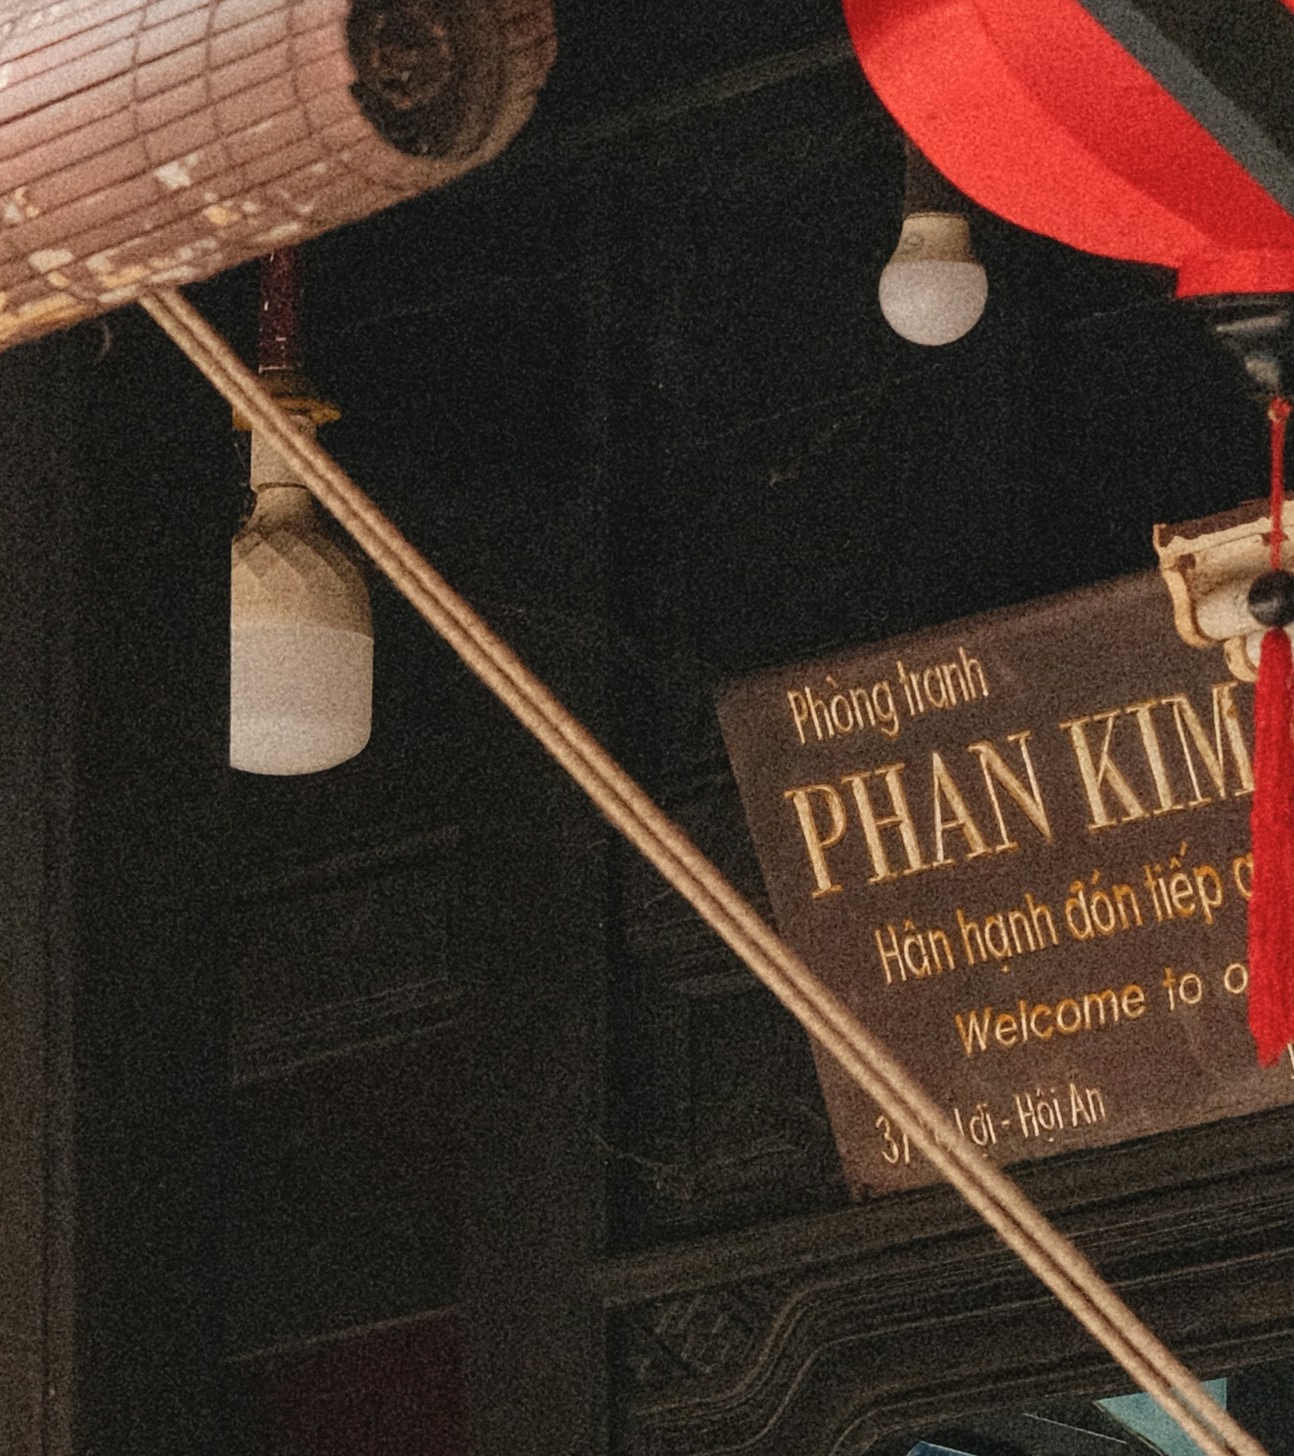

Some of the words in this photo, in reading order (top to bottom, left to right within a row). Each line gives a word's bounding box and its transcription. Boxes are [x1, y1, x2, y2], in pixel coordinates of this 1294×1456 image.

[786, 674, 900, 745] Phòng
[896, 646, 990, 716] tranh
[783, 730, 1054, 898] PHAN
[1059, 681, 1256, 834] KIM
[874, 918, 956, 986] Hân
[955, 892, 1060, 974] hạnh
[1064, 868, 1144, 942] đón
[1142, 840, 1224, 926] tiếp
[954, 983, 1147, 1057] Welcome
[1162, 966, 1203, 1012] to
[1015, 1087, 1065, 1143] Hội
[1069, 1082, 1108, 1128] An
